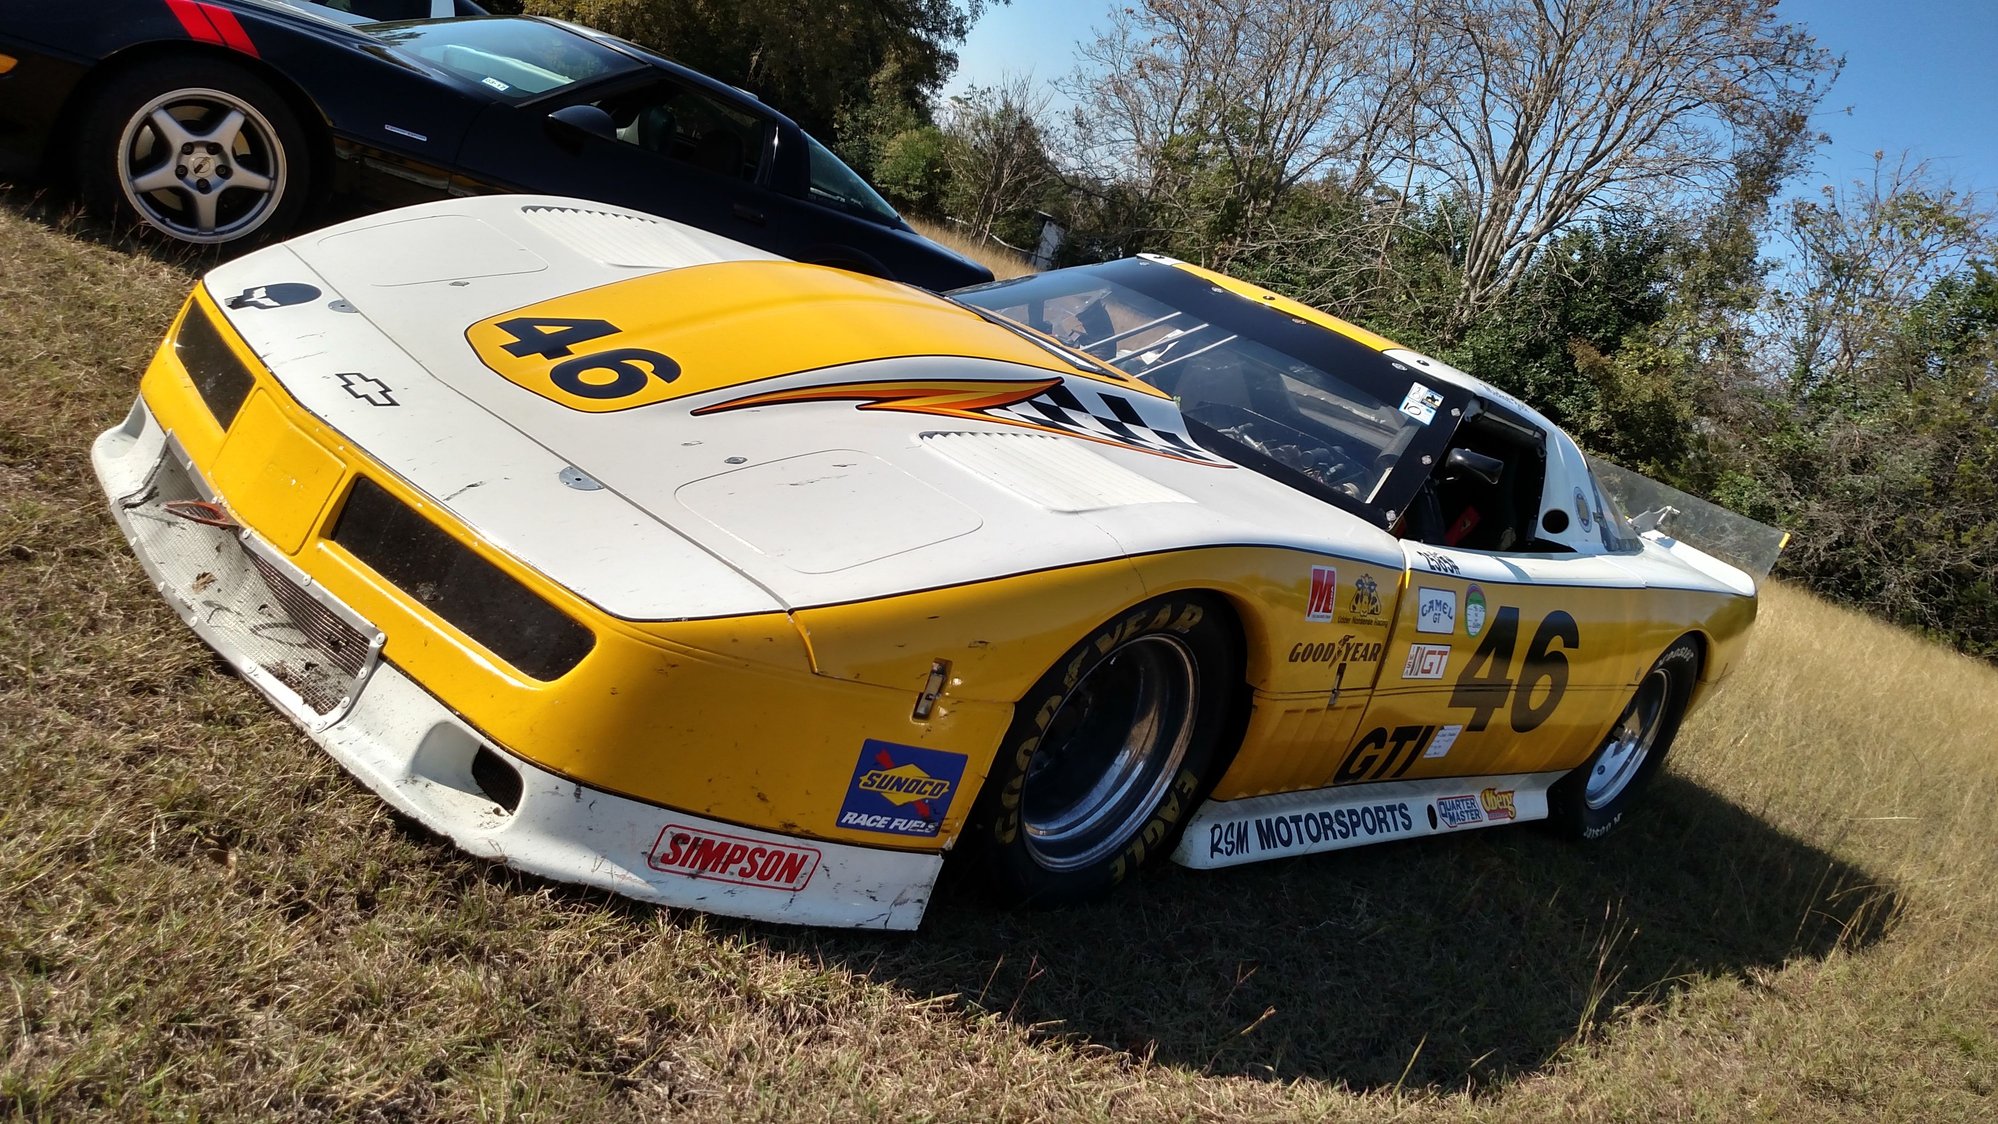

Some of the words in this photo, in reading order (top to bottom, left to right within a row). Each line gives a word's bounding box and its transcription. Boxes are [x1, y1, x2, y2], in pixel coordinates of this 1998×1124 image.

[494, 317, 682, 399] 46
[1421, 598, 1453, 620] CAMEL
[1432, 613, 1441, 624] GT
[1421, 649, 1449, 674] GT
[1448, 606, 1579, 733] 46
[863, 772, 949, 797] SUNOCO
[1439, 798, 1476, 818] QUARTER
[1448, 809, 1481, 826] MASTER
[841, 811, 891, 829] RACE
[889, 817, 939, 833] FUELS
[1210, 821, 1250, 859] RSM
[1255, 803, 1412, 850] MOTORSPORTS
[661, 832, 809, 884] SIMPSON
